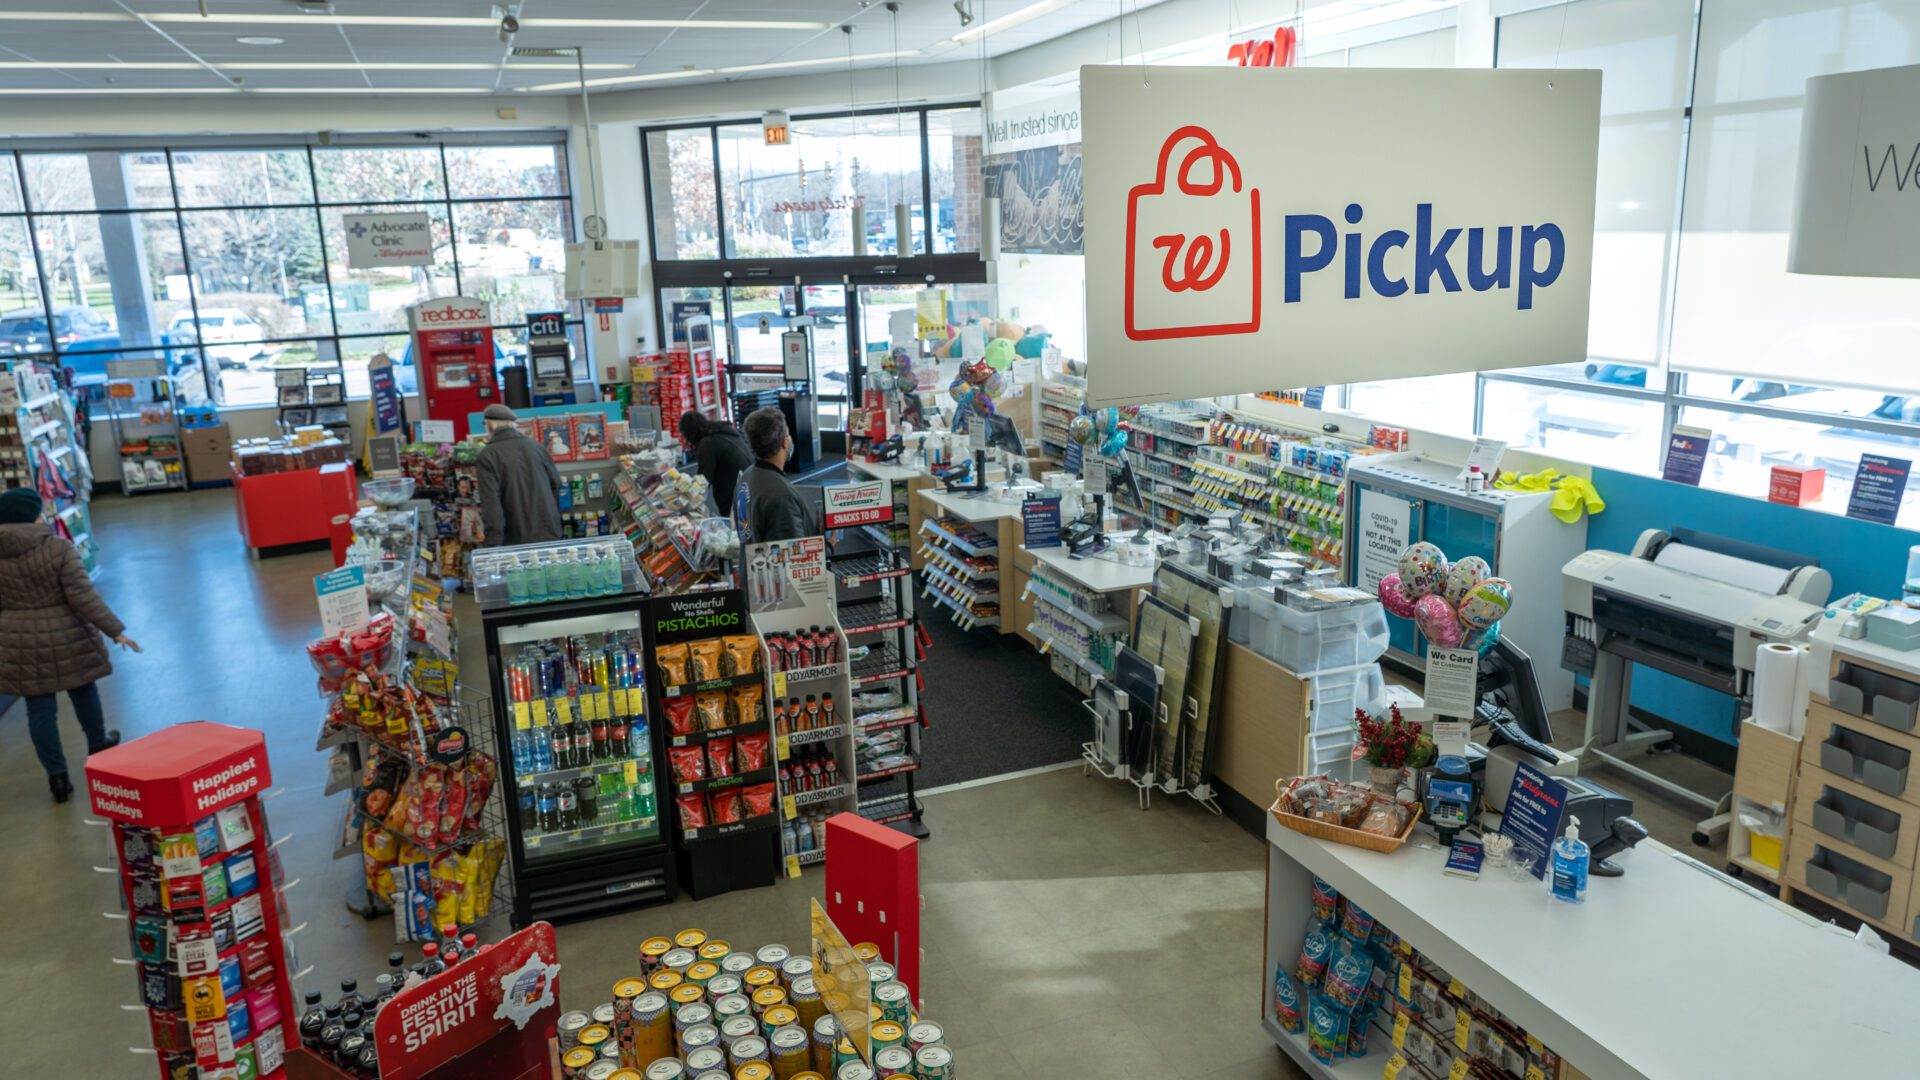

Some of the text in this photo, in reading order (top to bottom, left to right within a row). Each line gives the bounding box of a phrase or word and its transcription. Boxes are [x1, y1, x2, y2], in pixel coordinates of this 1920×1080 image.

[988, 108, 1079, 143] Well trusted since
[766, 126, 786, 144] EXIT
[1863, 142, 1920, 192] W
[370, 220, 426, 233] Advocate
[371, 234, 404, 247] Clinic
[1284, 203, 1566, 311] Pickup
[531, 317, 560, 335] citi
[833, 510, 880, 524] SNACKS TO GO
[1370, 512, 1398, 526] COVID-19
[1373, 521, 1394, 534] Testing
[1365, 530, 1377, 539] NOT
[1388, 536, 1402, 547] THIS
[1368, 540, 1398, 555] LOCATION
[792, 566, 821, 579] BETTER
[671, 597, 725, 611] Wonderful
[657, 612, 739, 632] PISTACHIOS
[1431, 651, 1474, 664] We Card
[1440, 661, 1472, 670] Customers
[786, 665, 838, 682] ODYARMOR
[697, 680, 732, 691] PISTACHIOS
[790, 727, 842, 744] ODYARMOR
[192, 756, 256, 794] Happiest
[1518, 766, 1545, 787] Introducing
[92, 779, 141, 801] Happiest
[198, 776, 258, 810] Holidays
[795, 786, 845, 805] ODYARMOR
[96, 797, 143, 818] Holidays
[1512, 789, 1548, 815] Join for FREE to
[401, 972, 477, 1019] DRINK IN THE
[402, 982, 478, 1035] FESTIVE
[404, 997, 479, 1053] SPIRIT
